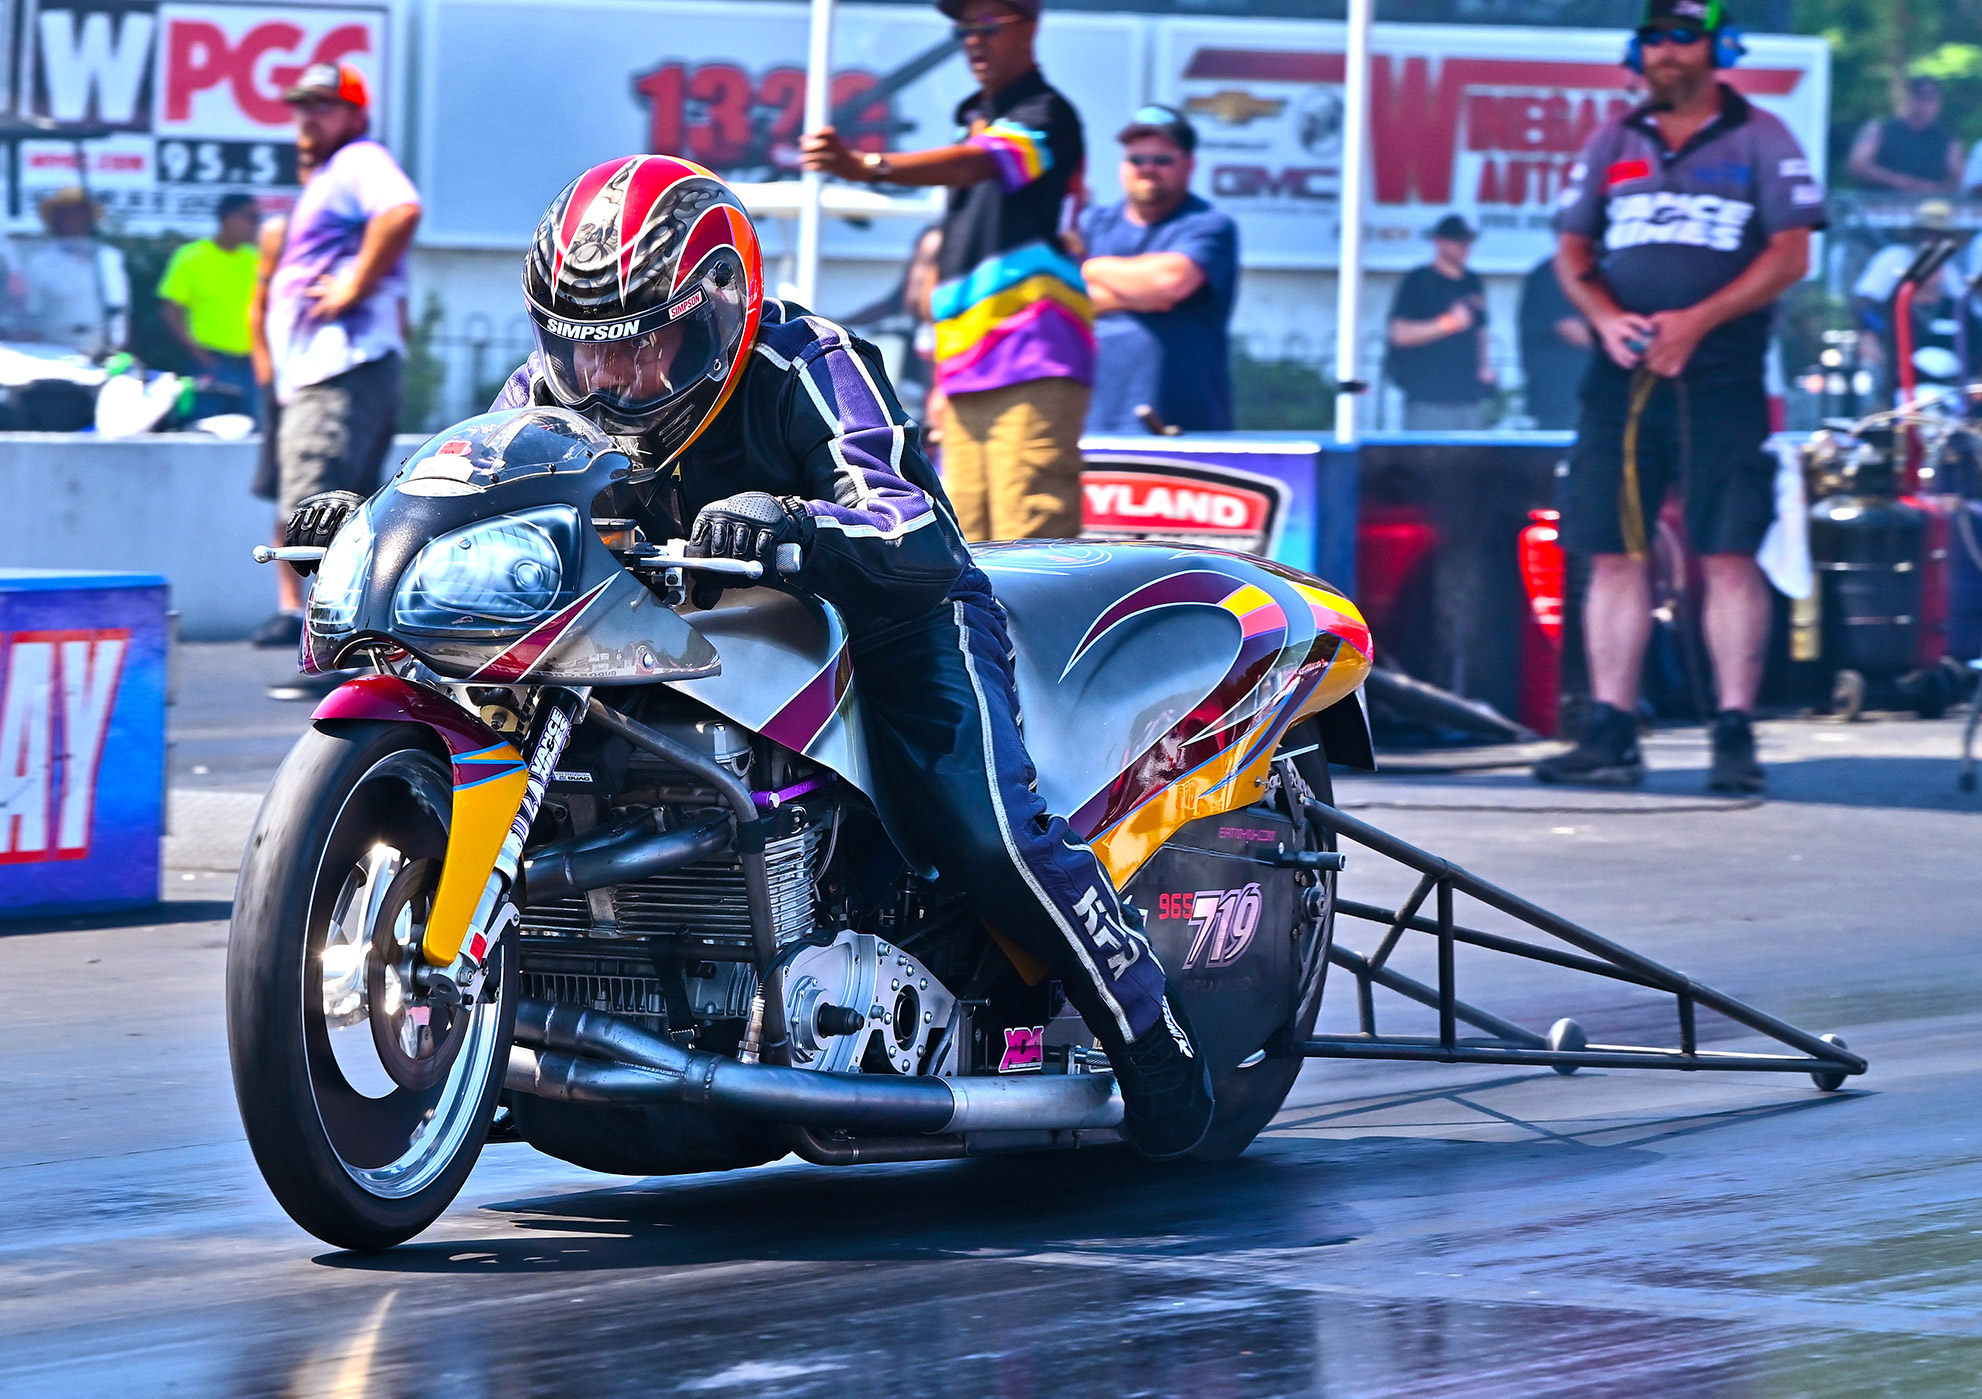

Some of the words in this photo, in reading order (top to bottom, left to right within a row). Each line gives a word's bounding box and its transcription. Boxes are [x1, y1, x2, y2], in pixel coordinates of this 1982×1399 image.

[162, 141, 278, 184] 95.5
[1212, 165, 1340, 199] GMC
[670, 292, 702, 319] SIMPSON
[547, 318, 641, 341] SIMPSON
[531, 709, 563, 773] VANCE
[1158, 893, 1194, 920] 965
[1182, 882, 1262, 970] 719
